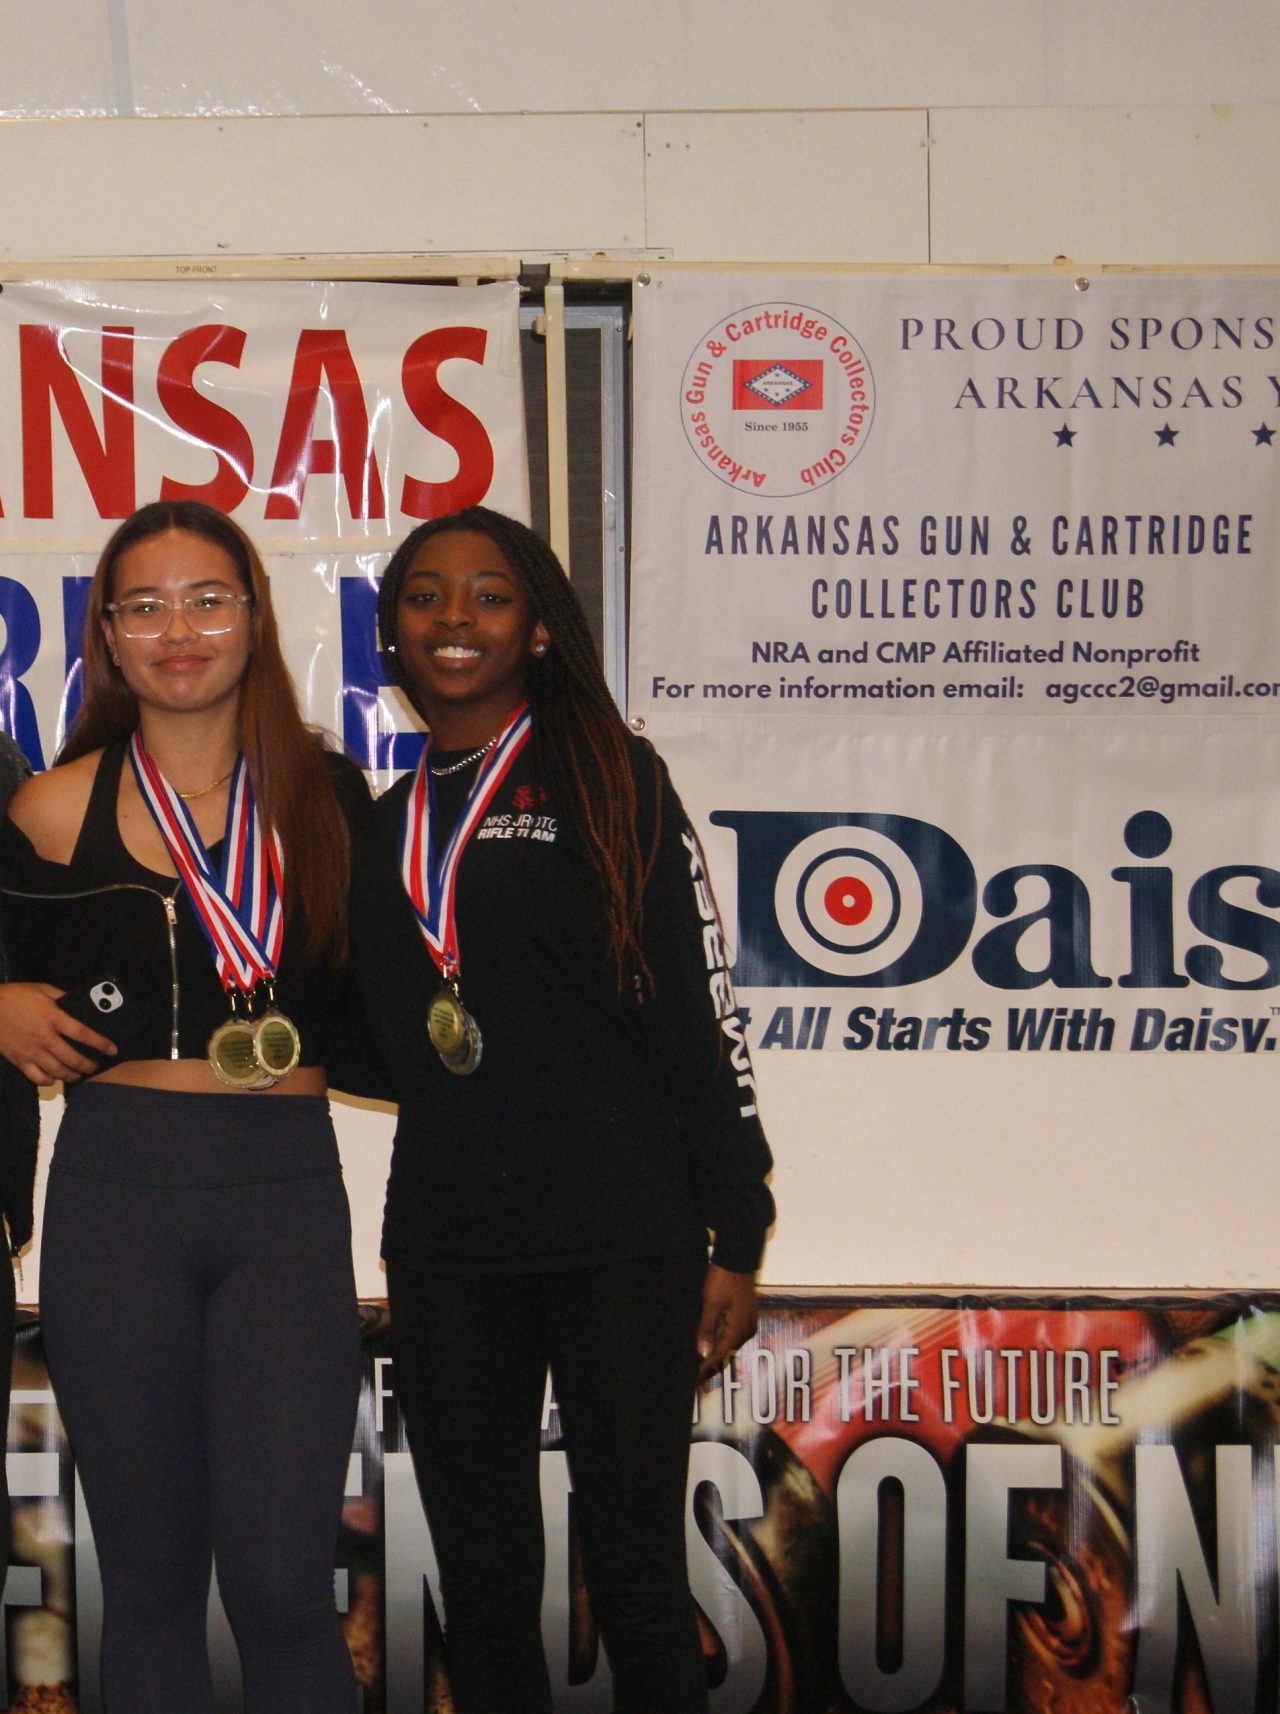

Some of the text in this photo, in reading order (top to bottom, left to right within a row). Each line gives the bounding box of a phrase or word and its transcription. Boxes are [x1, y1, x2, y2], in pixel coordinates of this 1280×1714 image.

[901, 316, 1274, 351] PROUD SPONS
[685, 310, 869, 487] Arkansas Gun & Cartridge Collectors Club
[955, 375, 1243, 409] ARKANSAS
[744, 421, 809, 432] Since 1955
[704, 514, 1253, 556] ARKANSAS GUN & CARTRIDGE
[811, 578, 1145, 619] COLLECTORS CLUB
[751, 640, 1201, 670] NRA and CMP Affiliated Nonprofit
[652, 677, 696, 699] For
[702, 683, 772, 699] more
[779, 675, 935, 699] information
[942, 675, 1024, 699] email:
[477, 827, 515, 840] RIFLE
[759, 1006, 832, 1050] All
[842, 1006, 992, 1052] Starts
[1007, 1007, 1117, 1052] With
[723, 1348, 814, 1425] FOR
[834, 1347, 920, 1424] THE
[942, 1347, 1120, 1426] FUTURE
[836, 1436, 1063, 1714] OF
[1135, 1444, 1280, 1714] N
